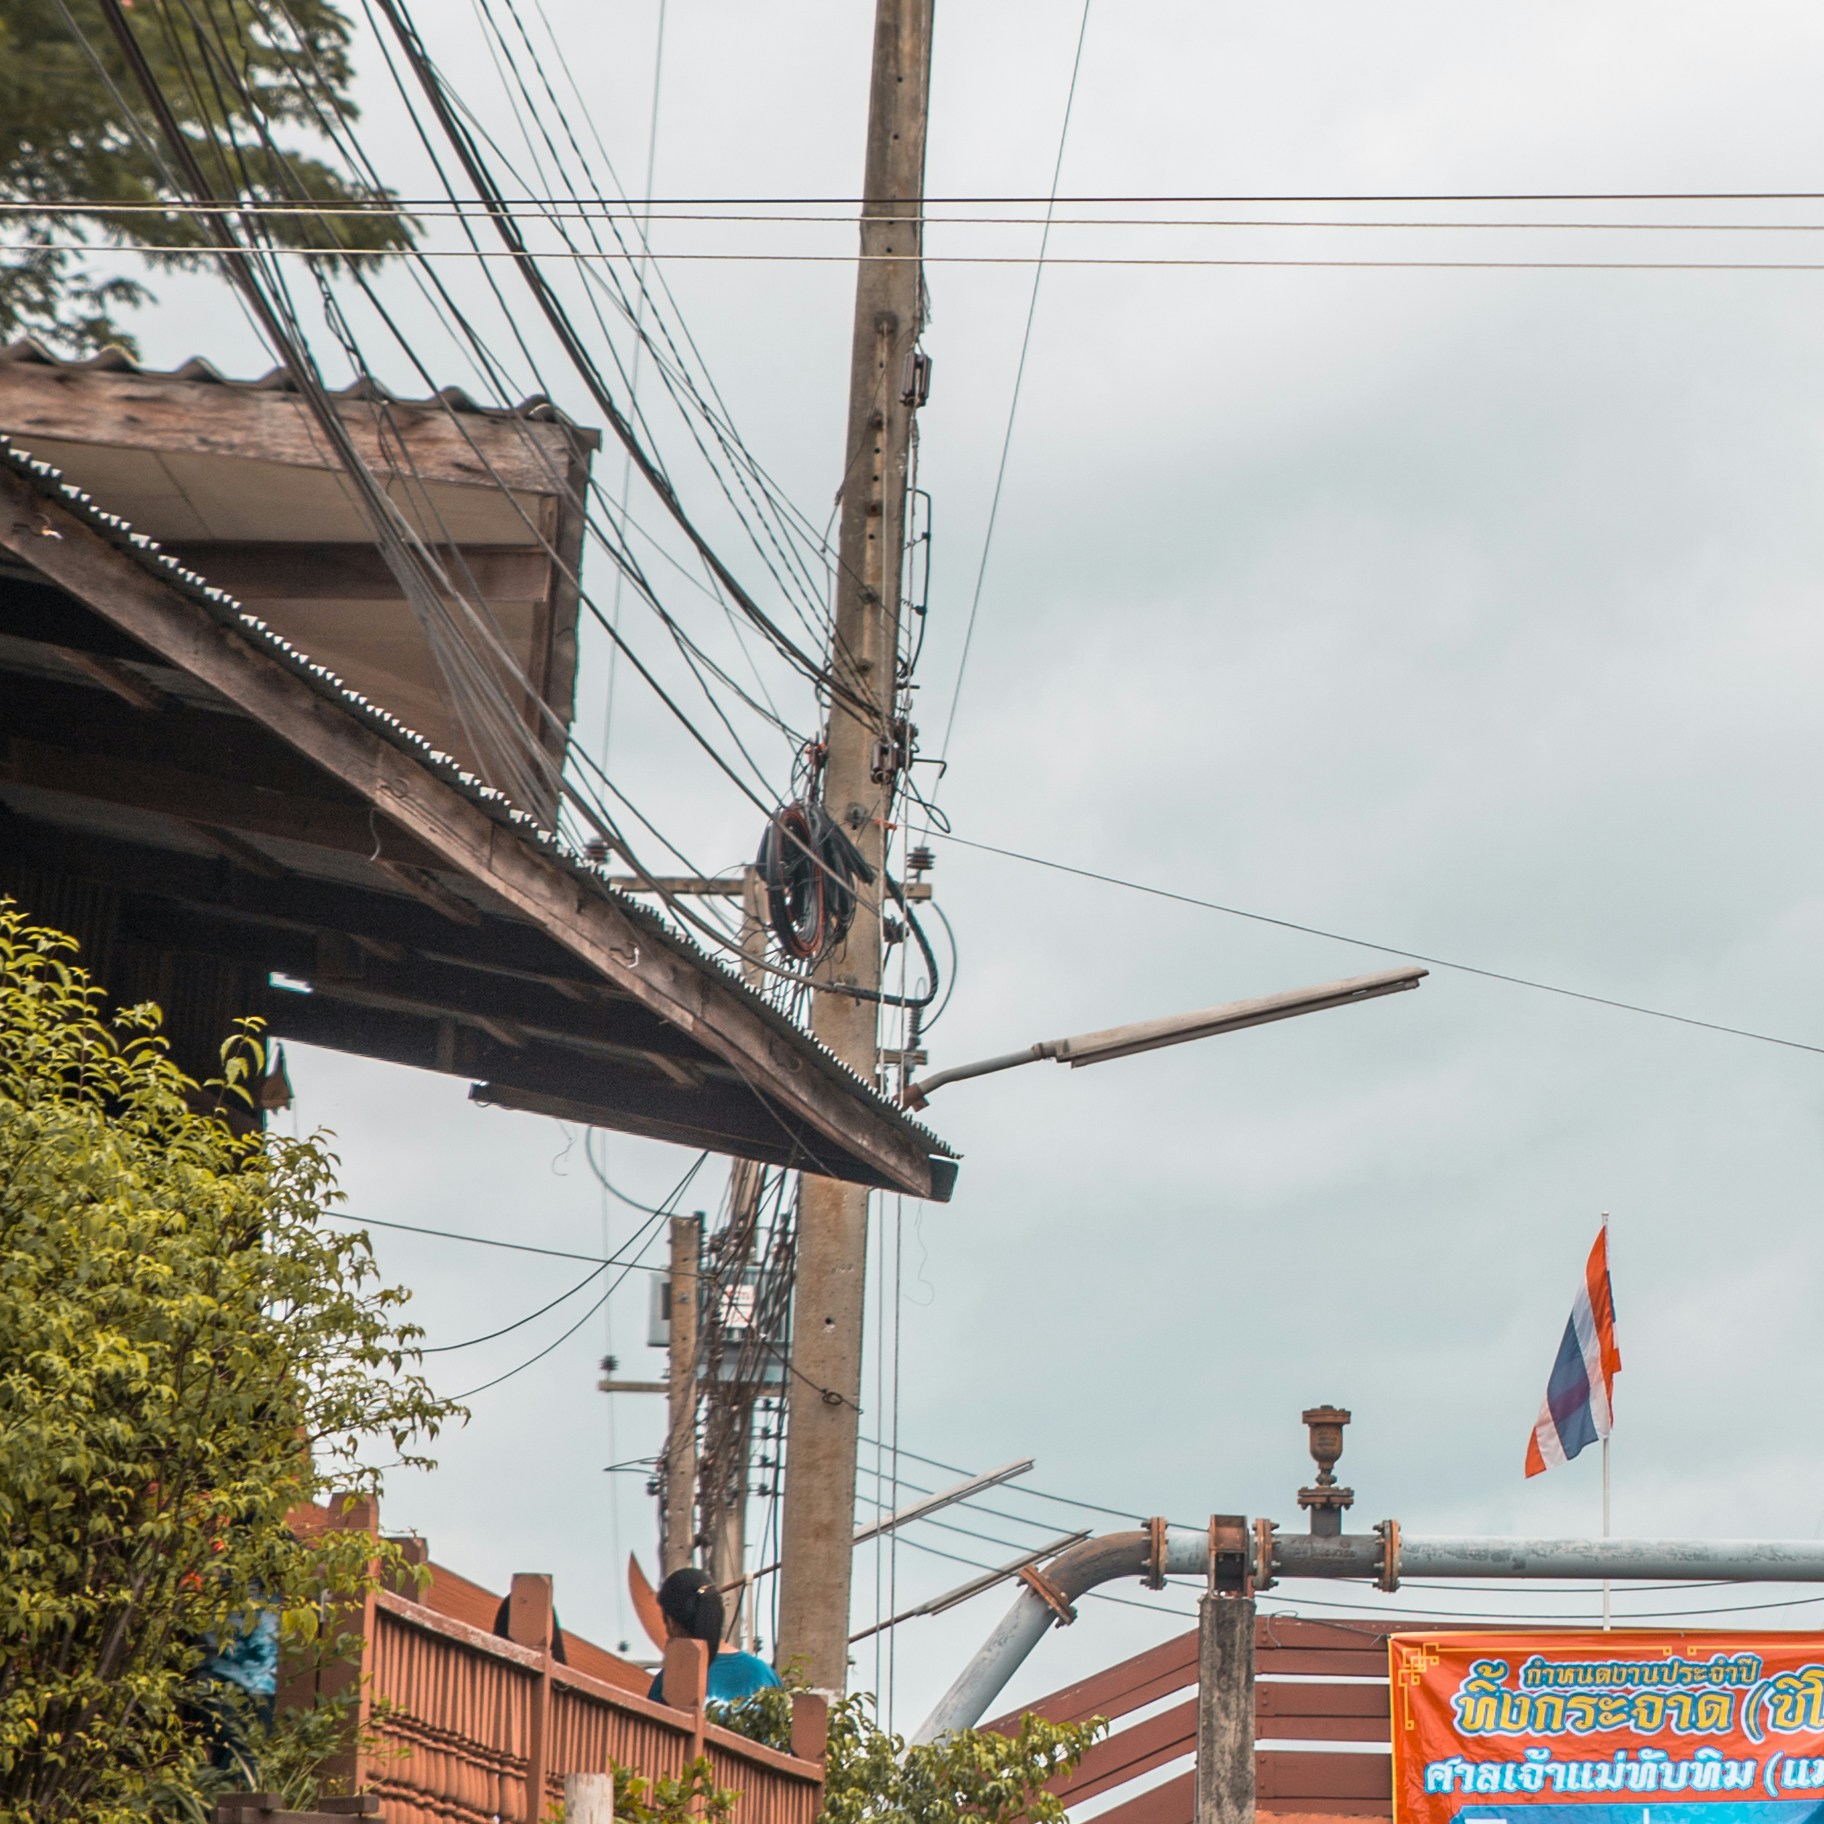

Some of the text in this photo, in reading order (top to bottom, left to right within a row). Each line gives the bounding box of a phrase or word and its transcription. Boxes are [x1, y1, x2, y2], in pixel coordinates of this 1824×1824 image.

[1524, 1656, 1761, 1687] กำหนดงานประจำปี
[1456, 1662, 1733, 1731] ทิ้งกระจาด
[1426, 1747, 1756, 1793] ศาลเจ้าแม่ทับทิม
